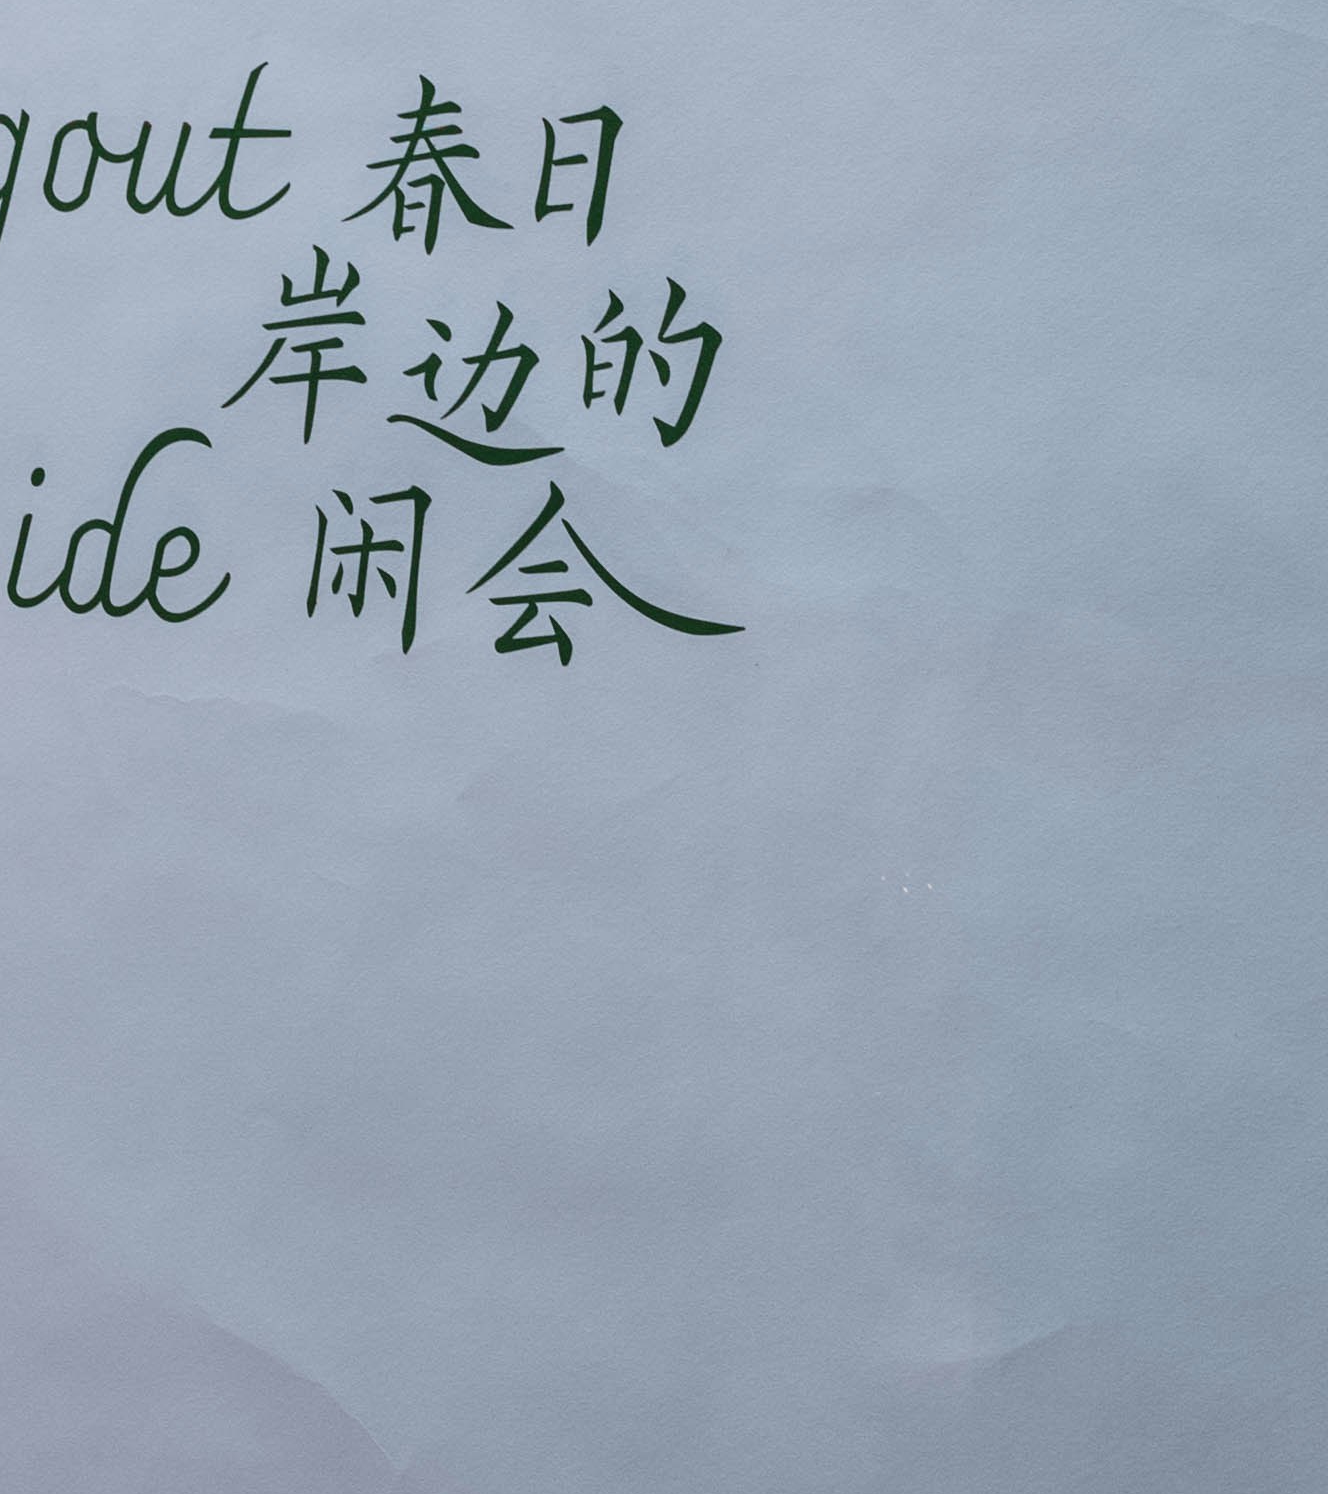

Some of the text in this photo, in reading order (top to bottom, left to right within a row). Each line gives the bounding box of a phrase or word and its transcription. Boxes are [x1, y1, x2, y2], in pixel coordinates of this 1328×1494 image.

[340, 74, 625, 256] 春日
[220, 243, 724, 467] 岸边的
[305, 480, 748, 667] 闲会
